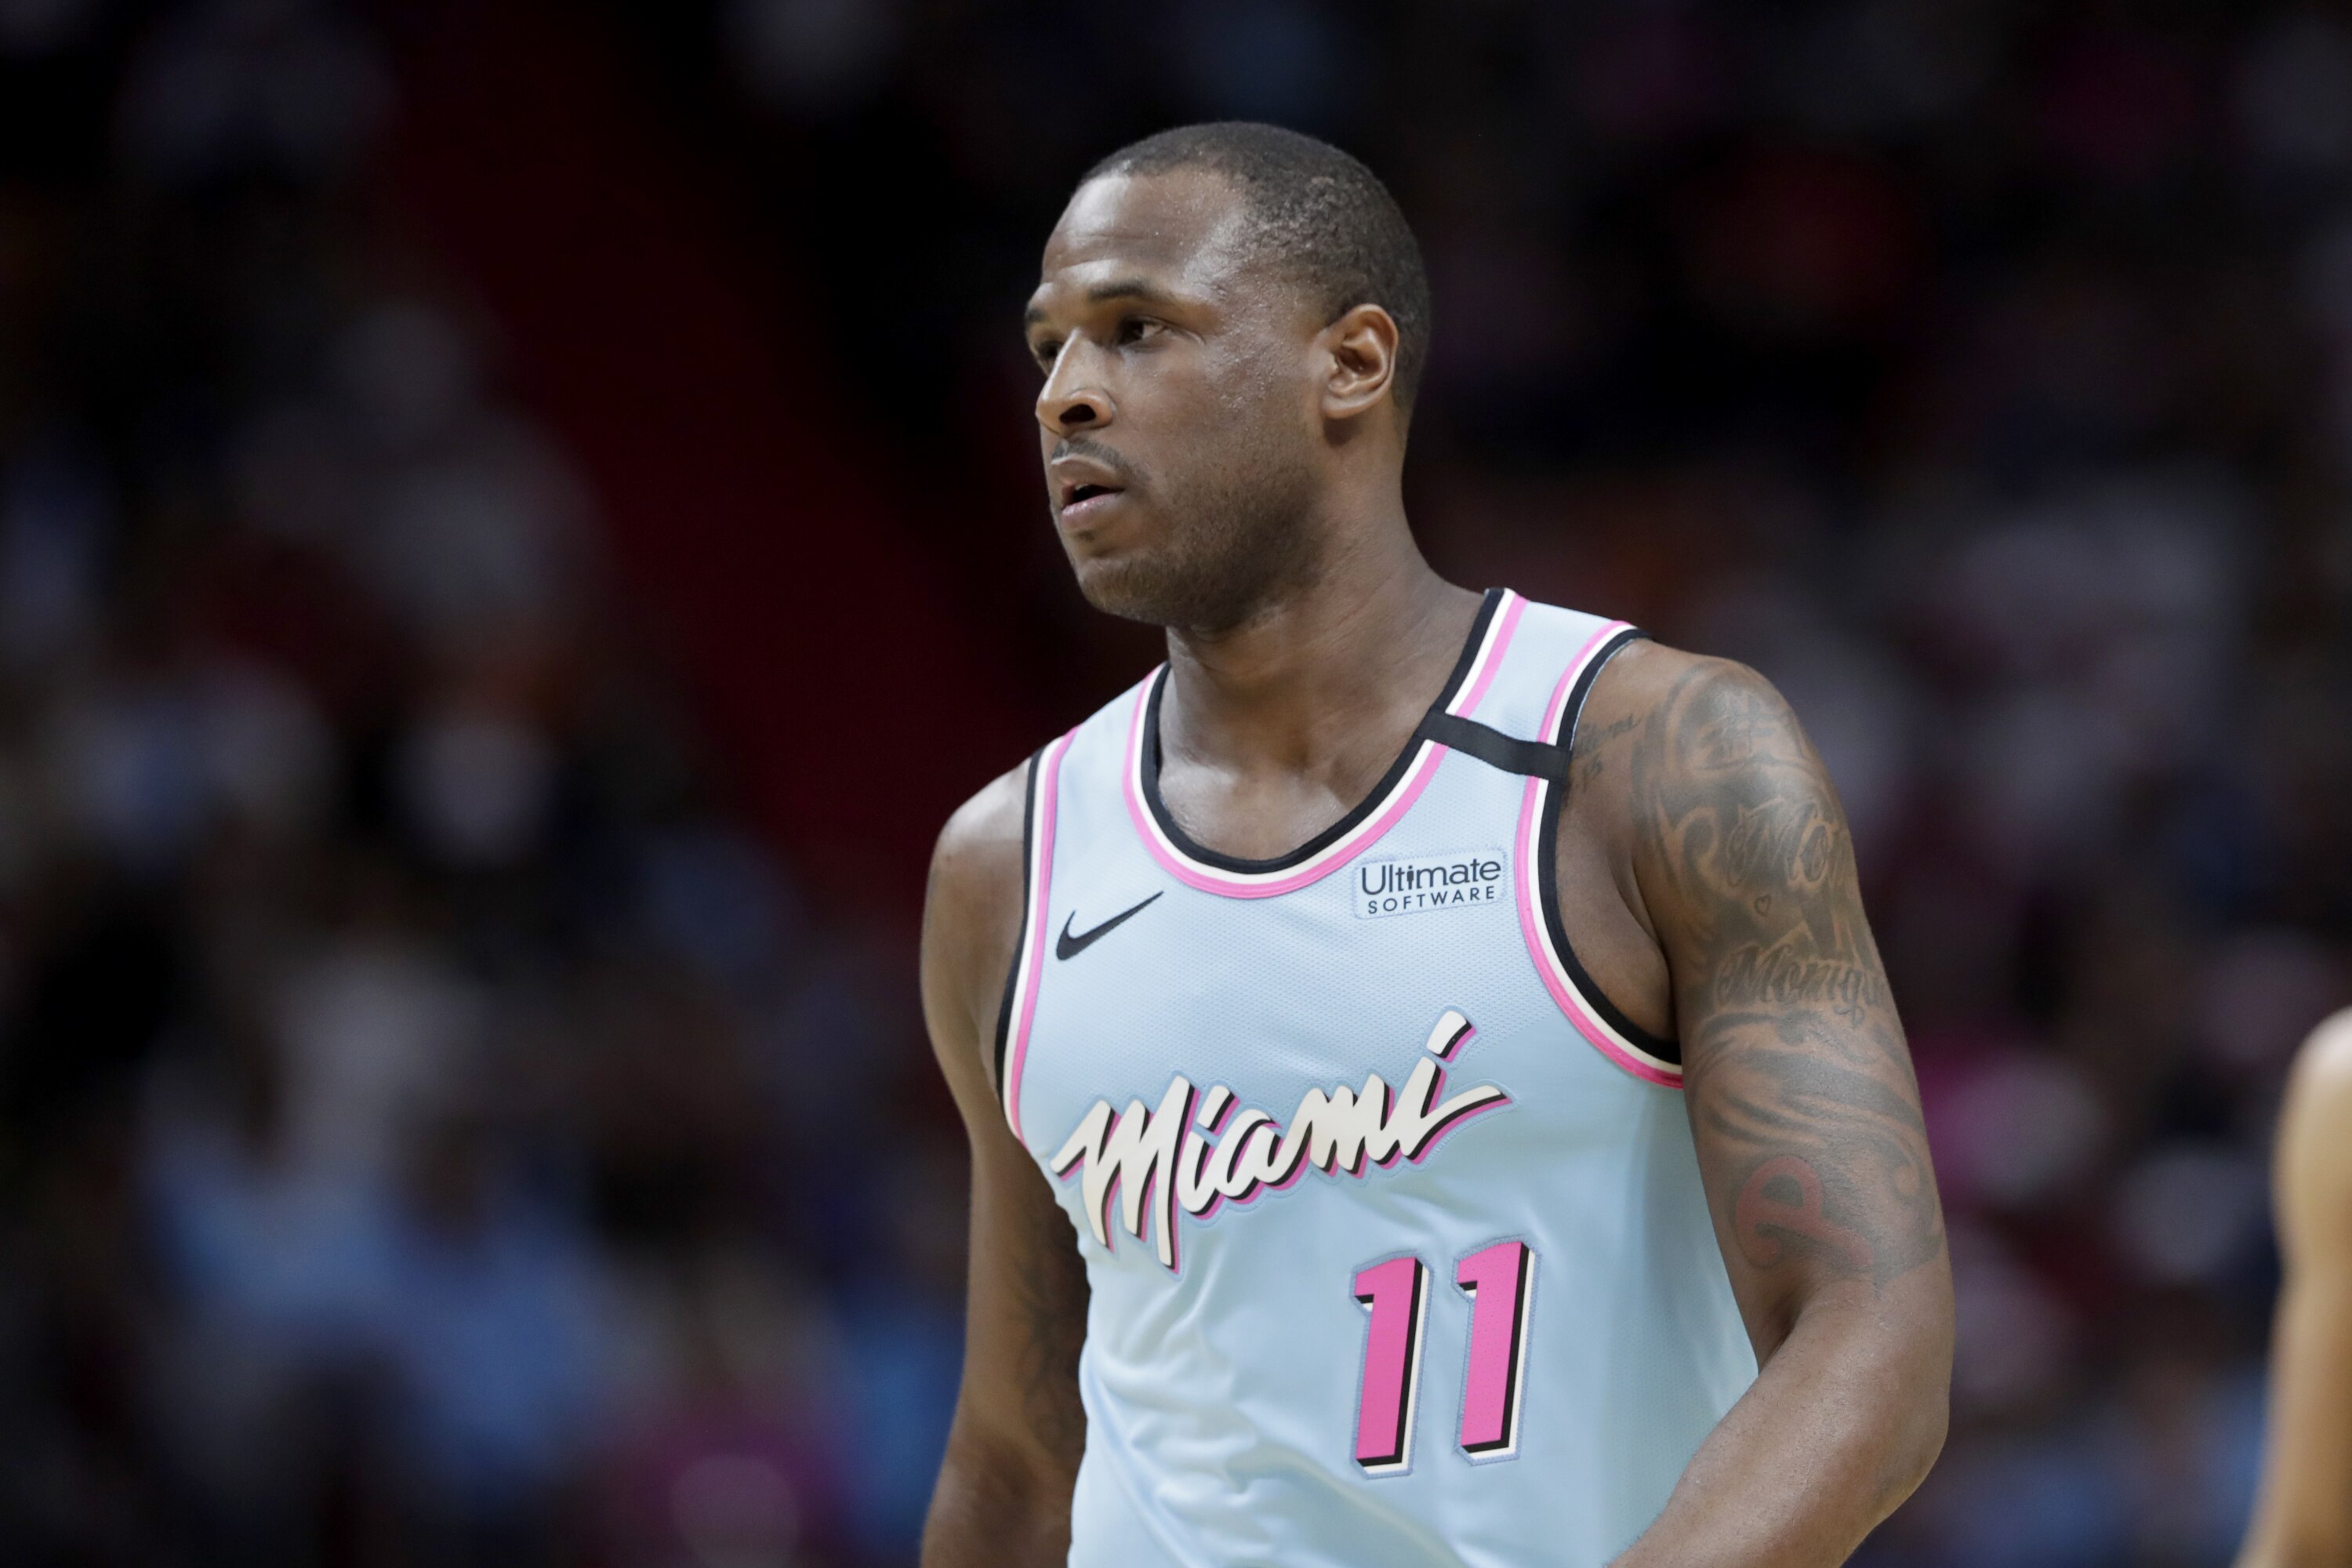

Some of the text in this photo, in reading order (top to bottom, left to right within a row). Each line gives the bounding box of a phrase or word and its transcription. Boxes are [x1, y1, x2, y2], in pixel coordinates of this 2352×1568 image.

[1361, 858, 1501, 895] Ultimate
[1367, 885, 1495, 914] SOFTWARE
[1050, 1009, 1512, 1275] Miami
[1353, 1240, 1536, 1475] 11
